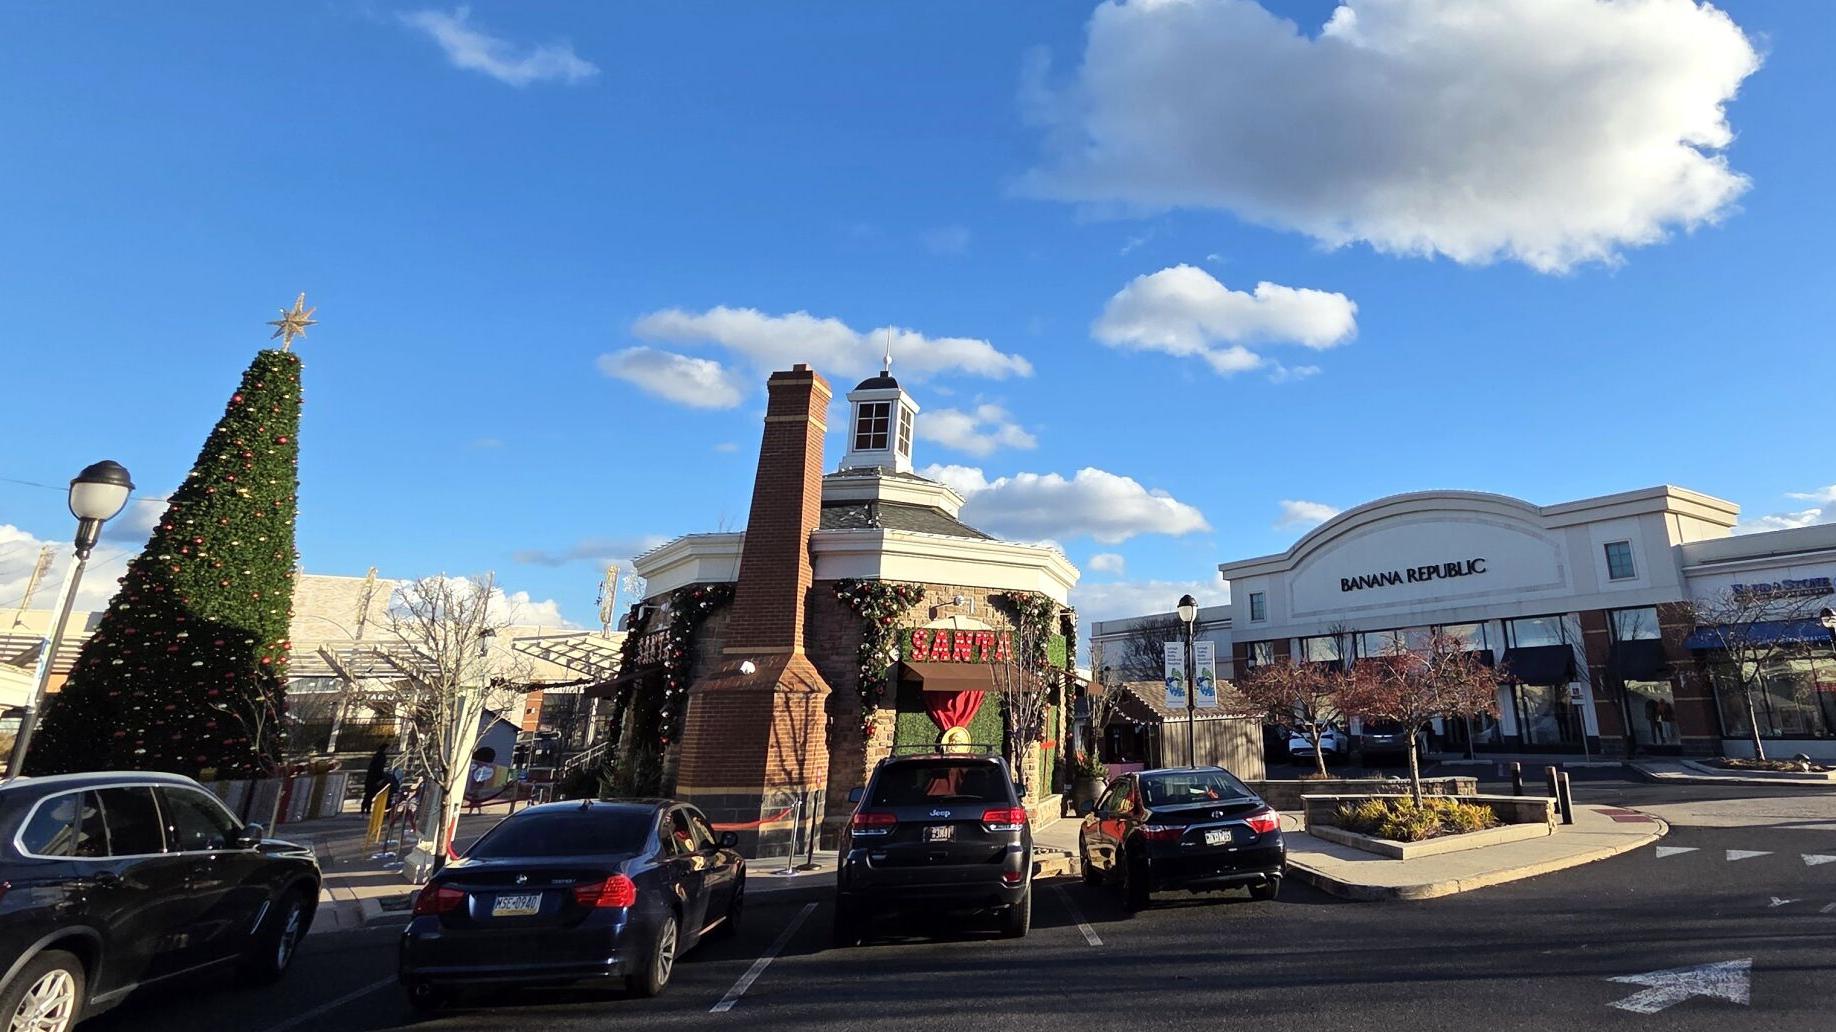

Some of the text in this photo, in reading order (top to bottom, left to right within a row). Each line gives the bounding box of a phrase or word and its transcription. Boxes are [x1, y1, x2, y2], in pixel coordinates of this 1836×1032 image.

[1340, 558, 1487, 592] BANANA REPUBLIC
[911, 629, 1014, 662] SANTA
[929, 809, 951, 818] Jeep
